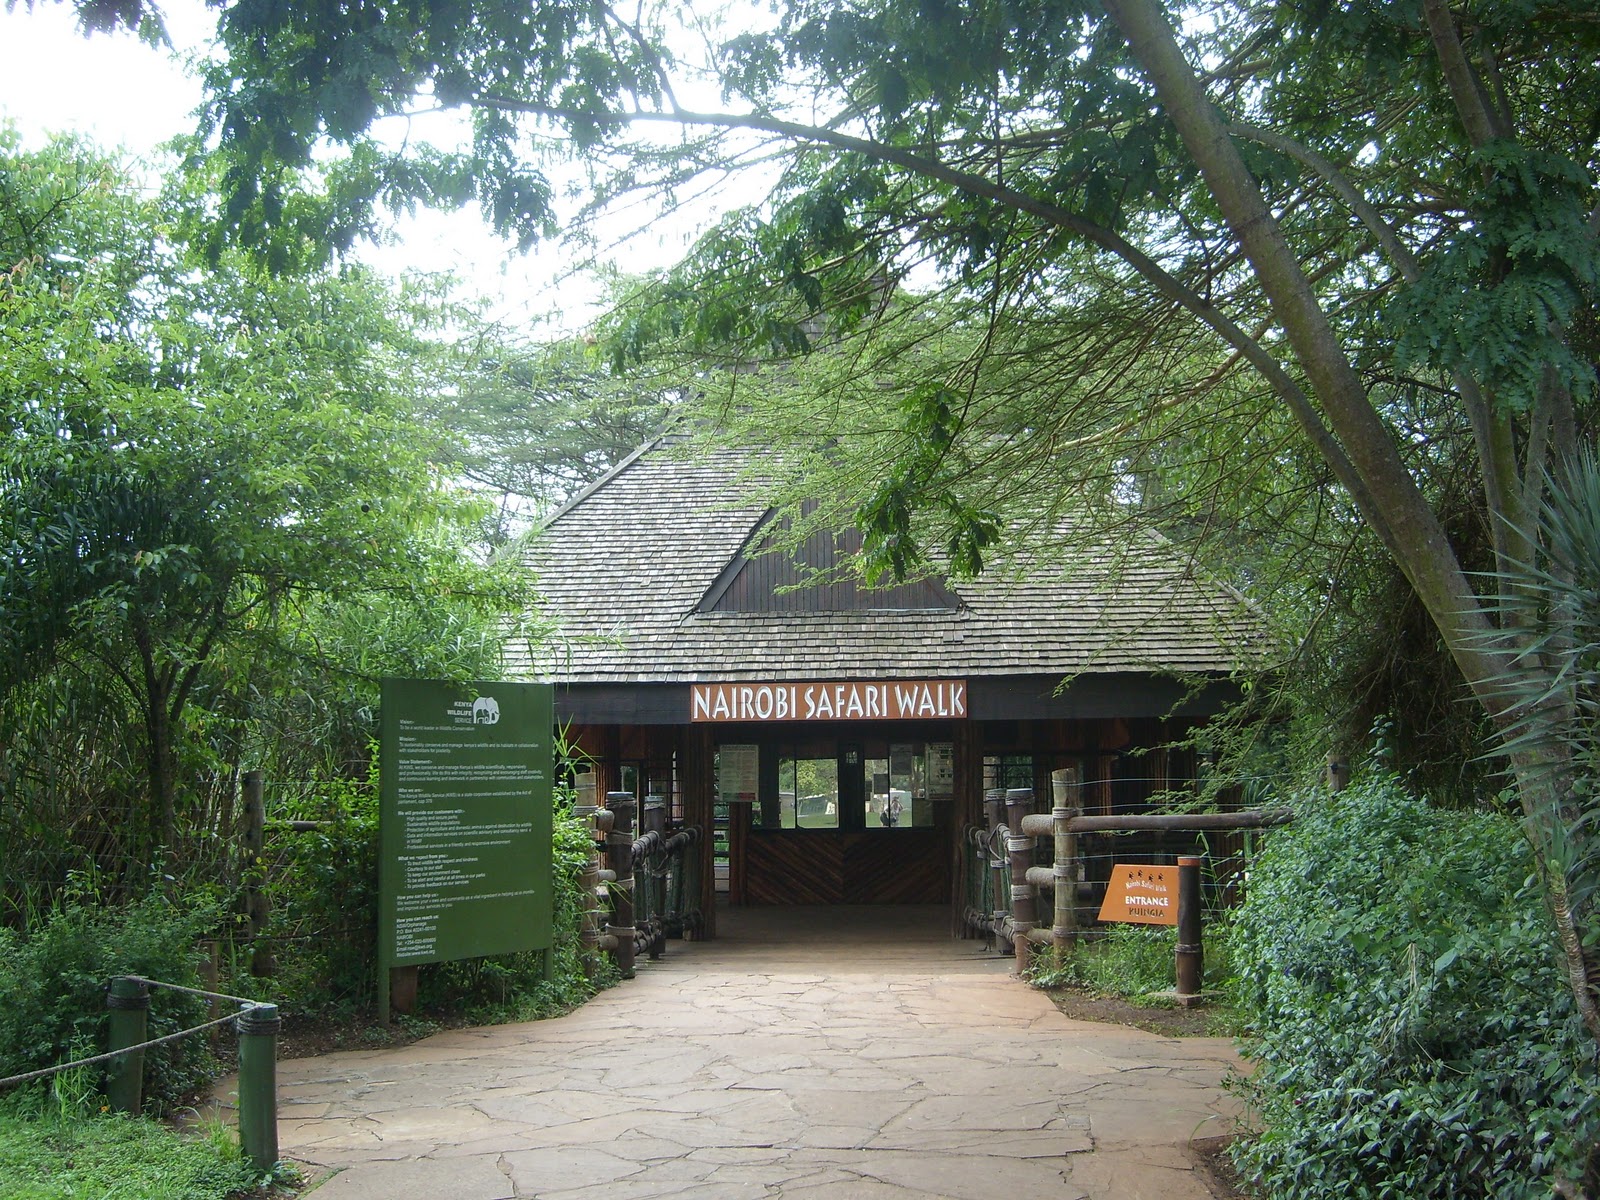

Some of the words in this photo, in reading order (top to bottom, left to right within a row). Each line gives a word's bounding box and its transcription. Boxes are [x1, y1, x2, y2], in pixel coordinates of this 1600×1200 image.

[693, 686, 797, 719] NAIROBI
[804, 684, 887, 719] SAFARI
[894, 683, 965, 717] WALK
[1125, 880, 1140, 889] Nairobi
[1141, 880, 1154, 889] Safari
[1125, 896, 1168, 906] ENTRANCE
[1129, 907, 1165, 917] KUINGIA
